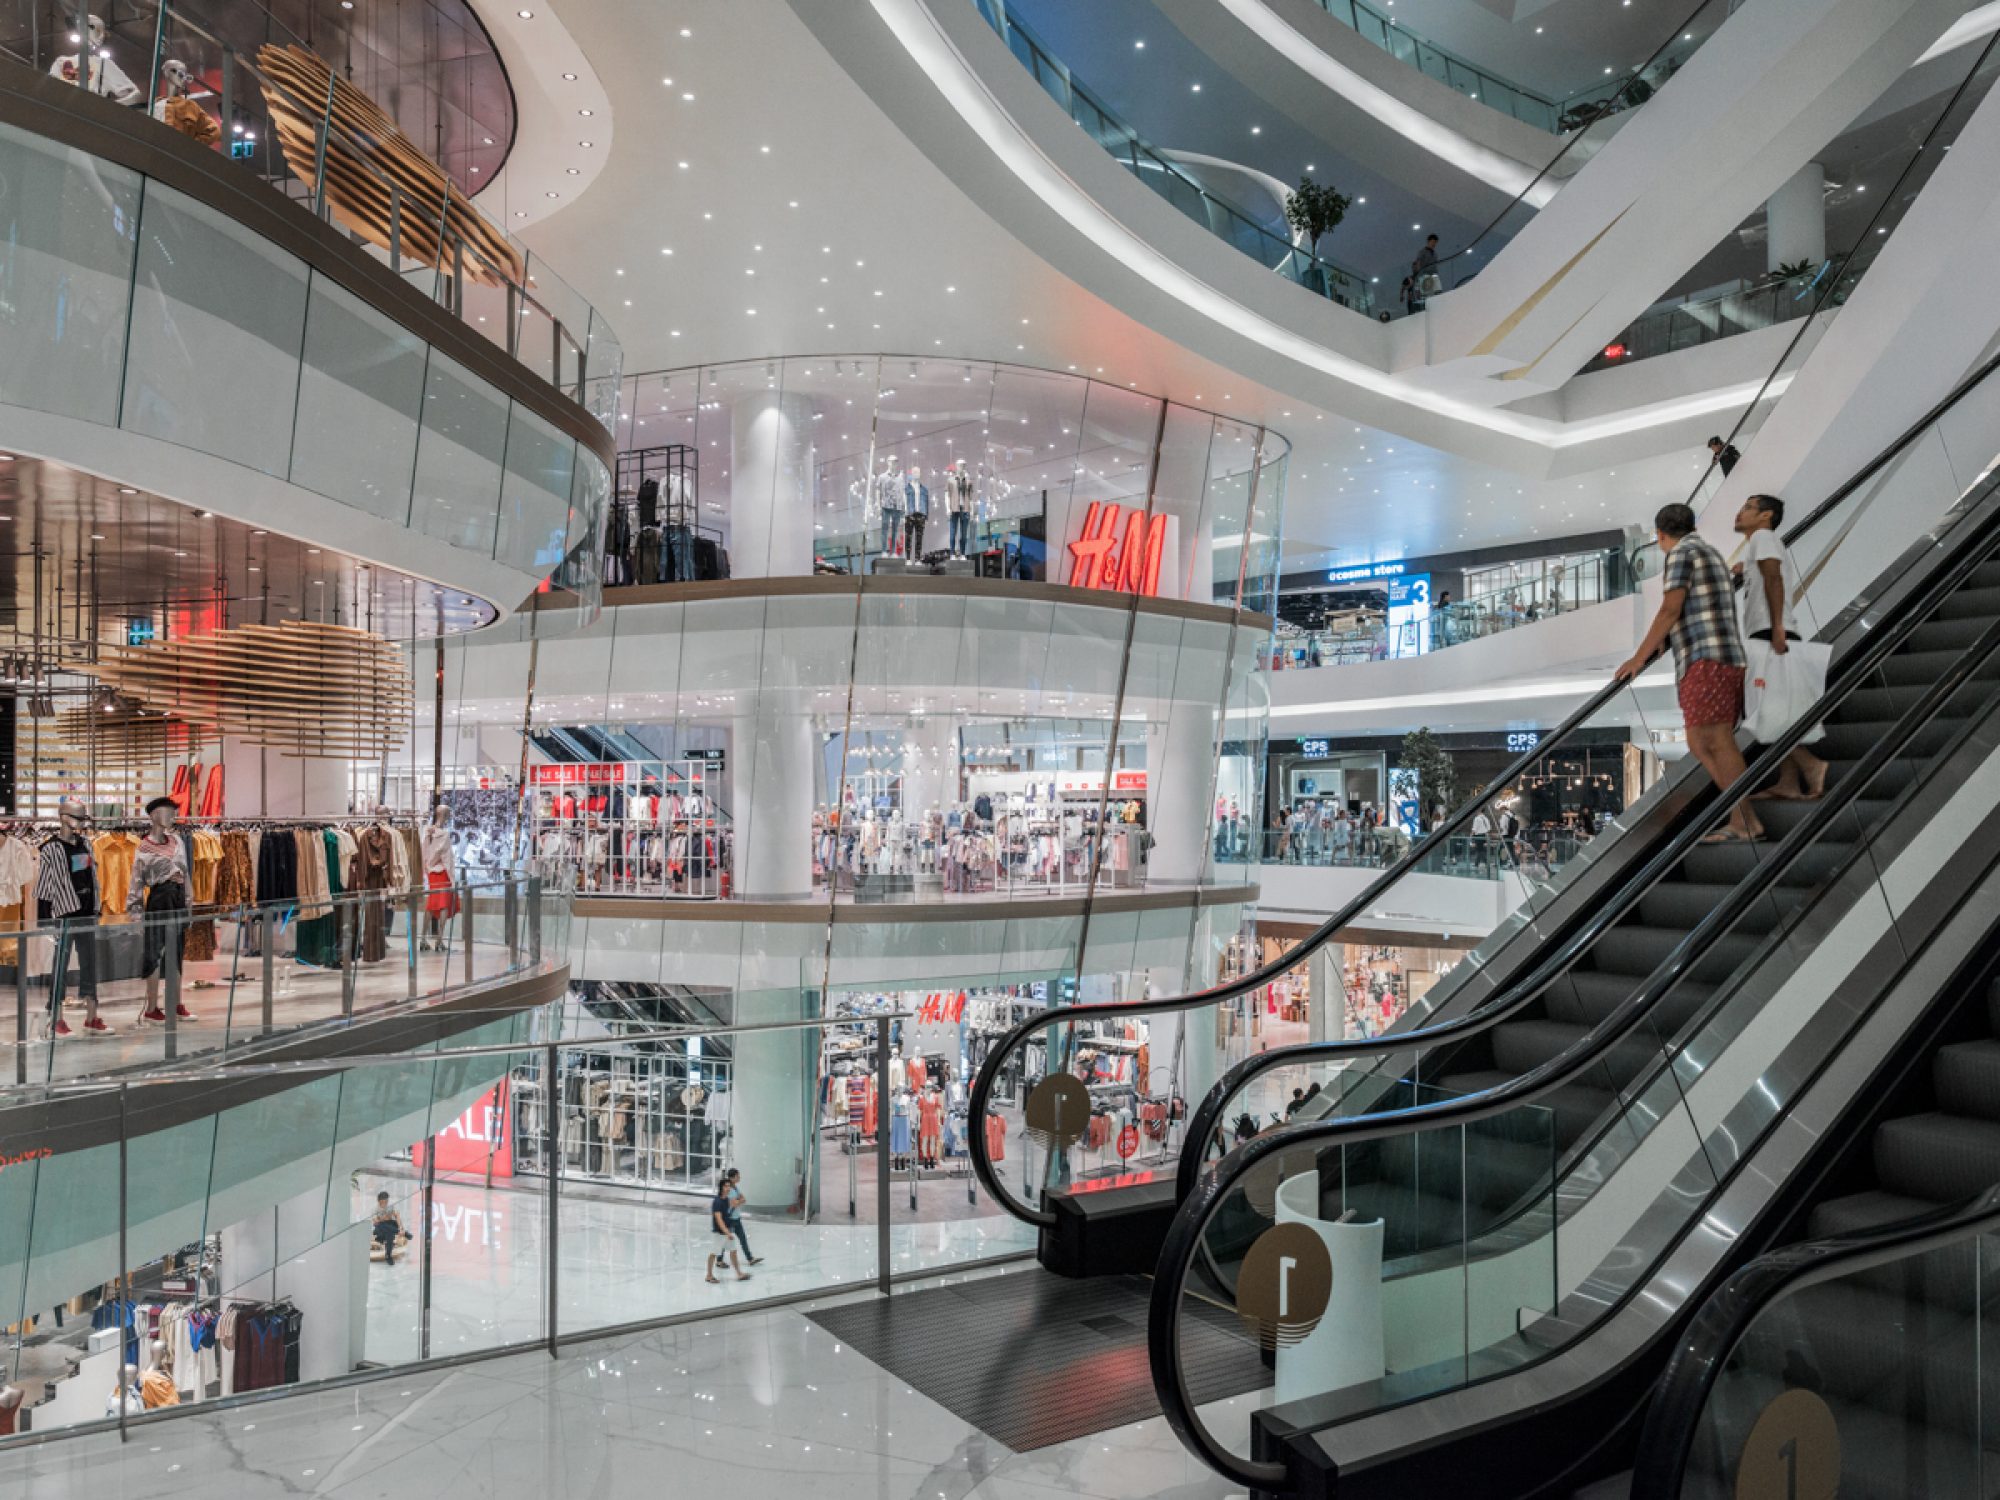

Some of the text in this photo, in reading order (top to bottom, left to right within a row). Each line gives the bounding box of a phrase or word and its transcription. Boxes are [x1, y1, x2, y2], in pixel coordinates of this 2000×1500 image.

[1068, 501, 1167, 597] H&M
[1412, 579, 1429, 606] 3
[1303, 741, 1328, 752] CPS
[1507, 732, 1538, 746] CPS
[440, 1105, 504, 1143] ALE
